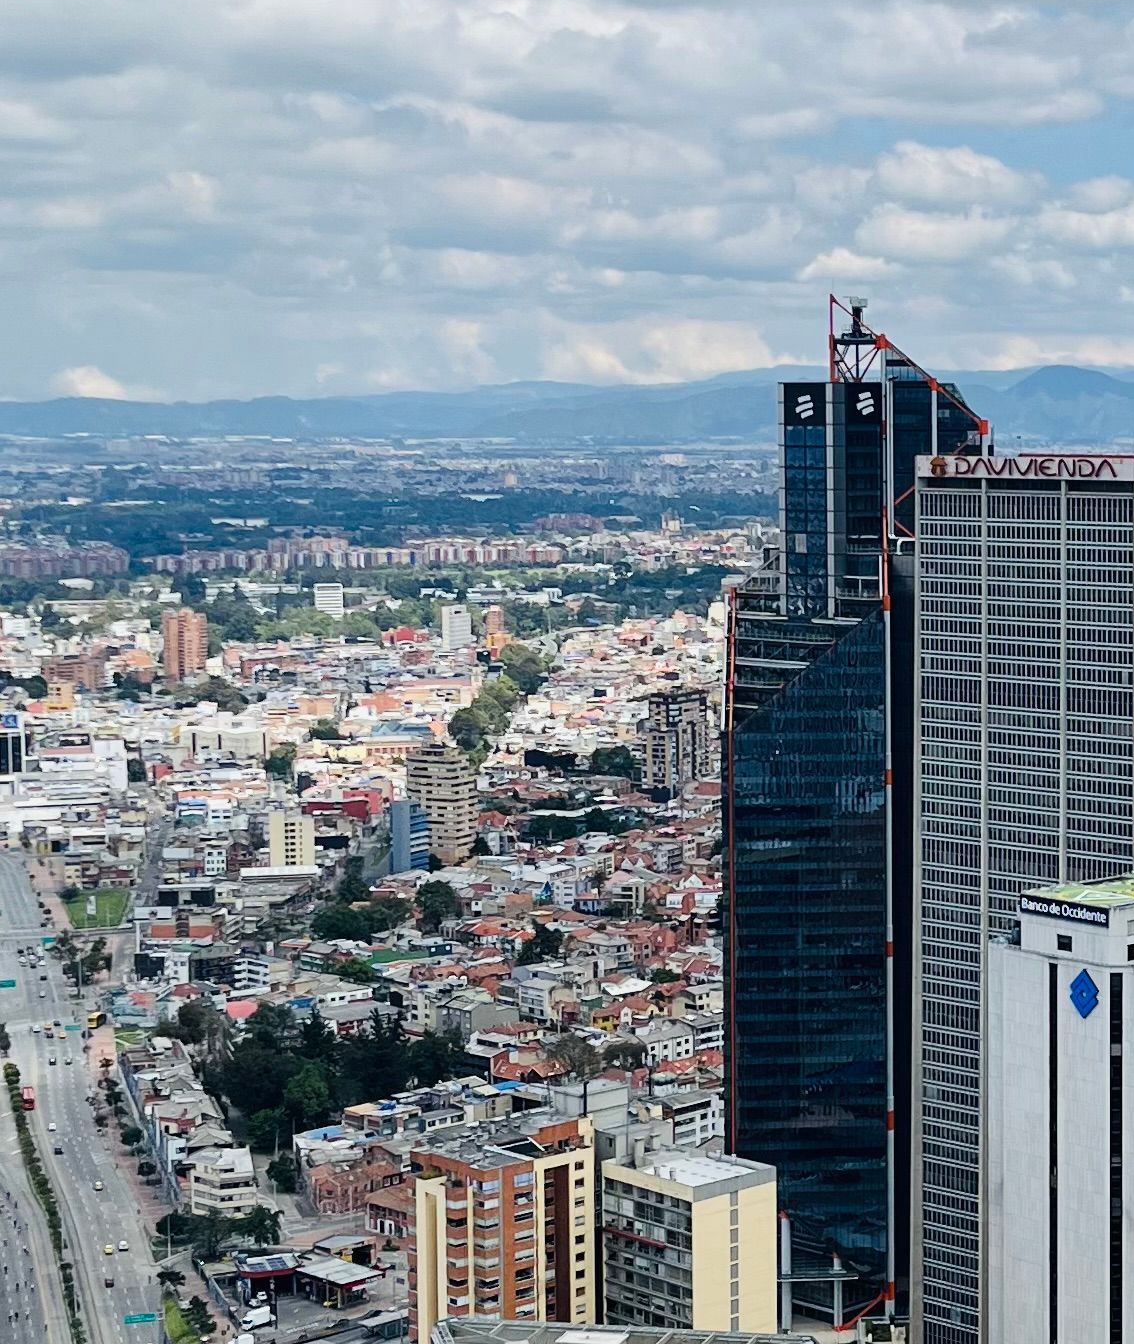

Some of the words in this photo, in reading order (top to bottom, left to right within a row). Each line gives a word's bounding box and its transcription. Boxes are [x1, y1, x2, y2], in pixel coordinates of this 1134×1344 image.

[954, 457, 1117, 478] DAVIVIENDA
[1021, 897, 1048, 913] Banco
[1049, 903, 1060, 915] de
[1061, 904, 1107, 923] Occidente
